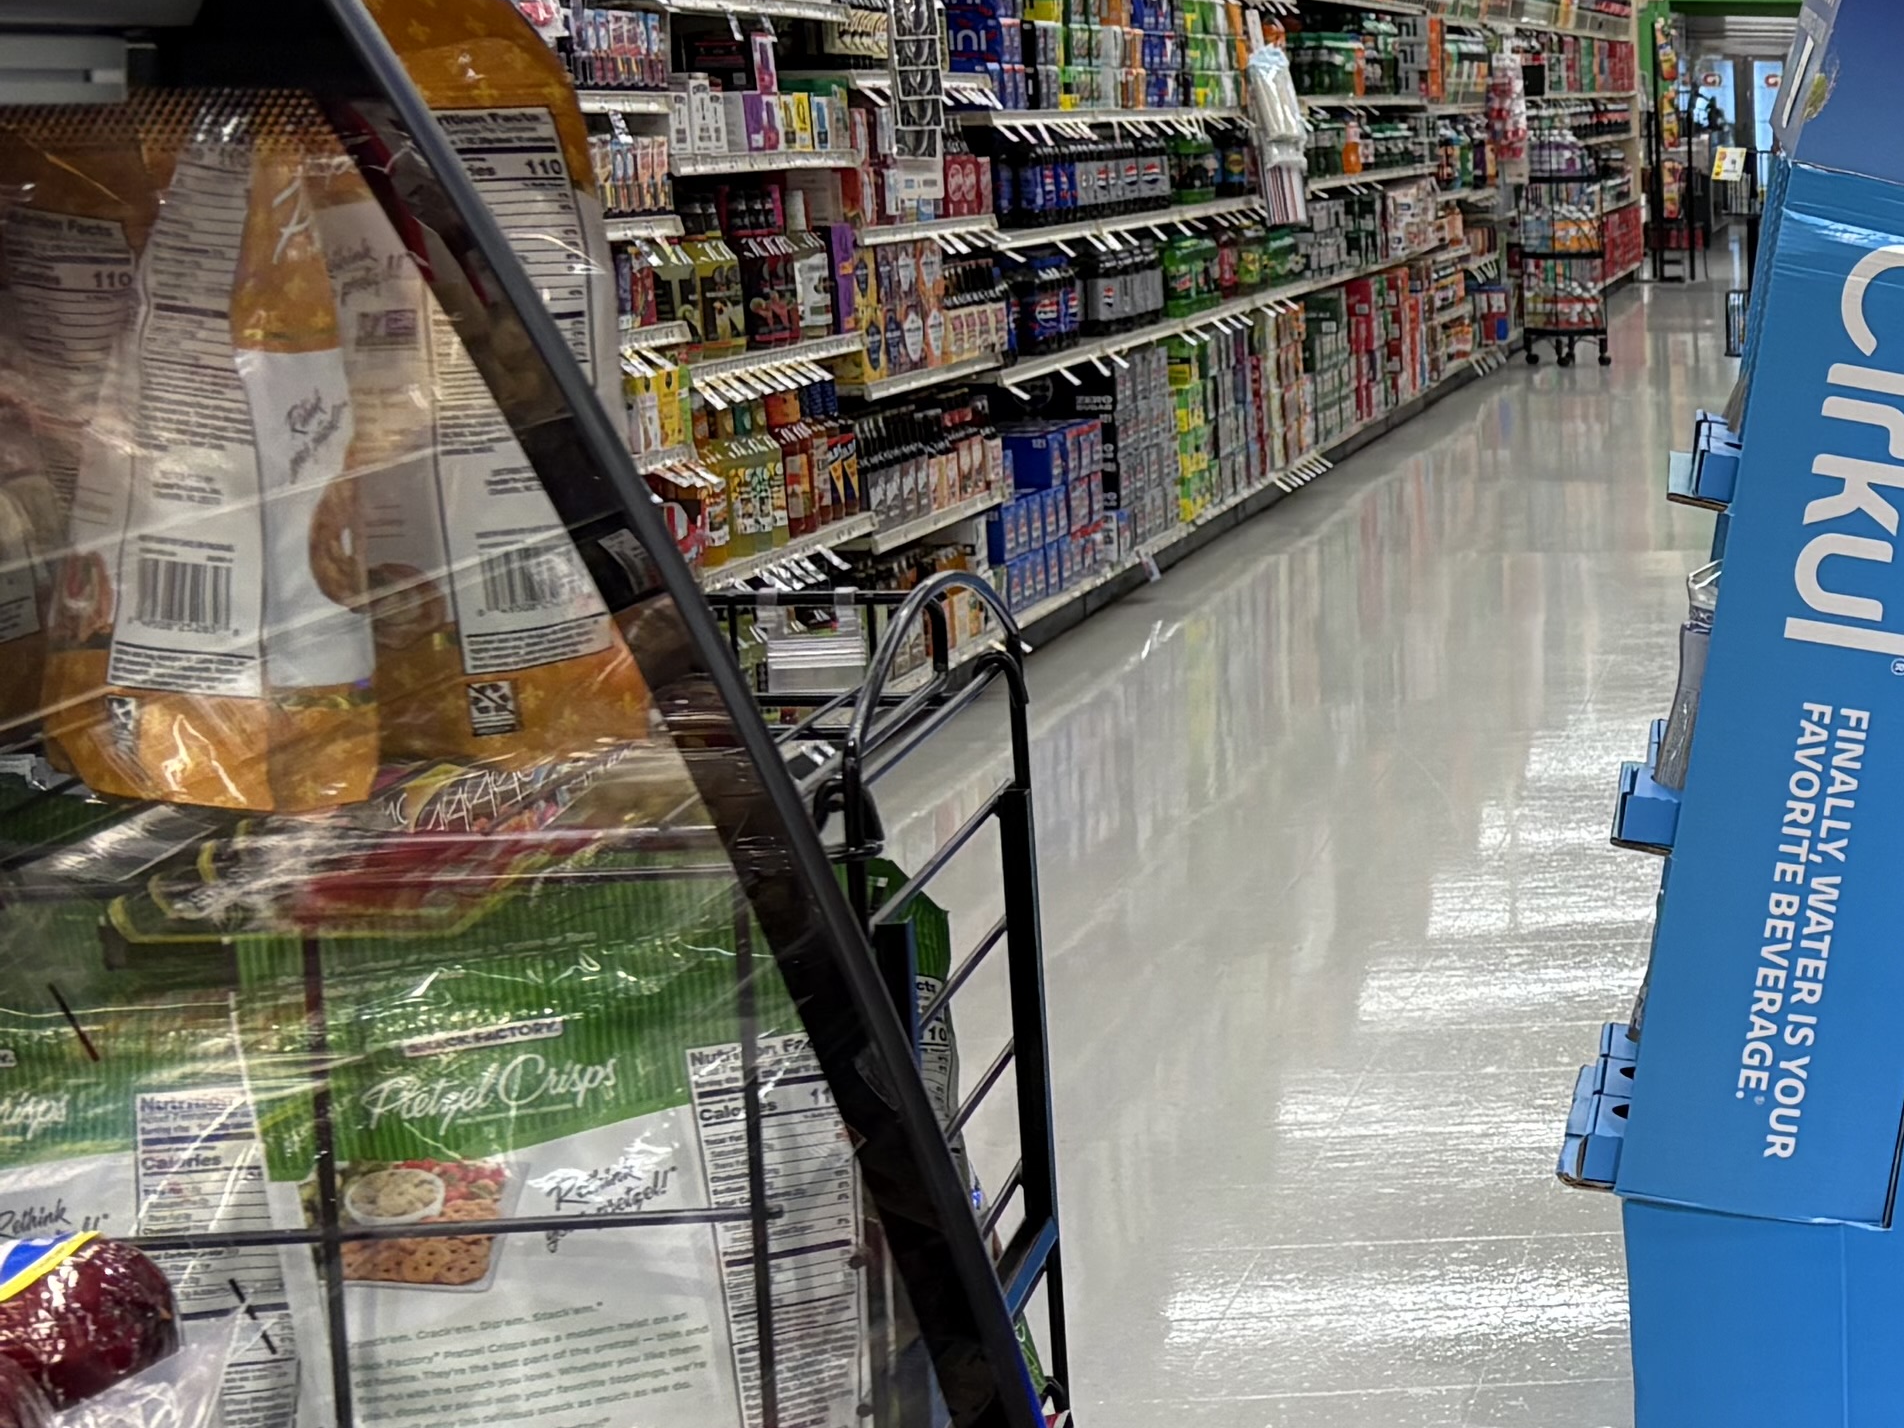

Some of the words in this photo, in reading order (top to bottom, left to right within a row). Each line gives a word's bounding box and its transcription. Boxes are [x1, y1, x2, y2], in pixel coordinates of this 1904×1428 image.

[525, 157, 562, 178] 110
[1773, 701, 1832, 885] FAVORITE
[1809, 707, 1870, 864] FINALLY,
[1735, 892, 1800, 1100] BEVERAGE.
[1789, 875, 1842, 1006] WATER
[1783, 1015, 1817, 1048] IS
[361, 1068, 497, 1134] Pretzel
[500, 1053, 618, 1121] Crisps
[1763, 1053, 1810, 1159] YOUR
